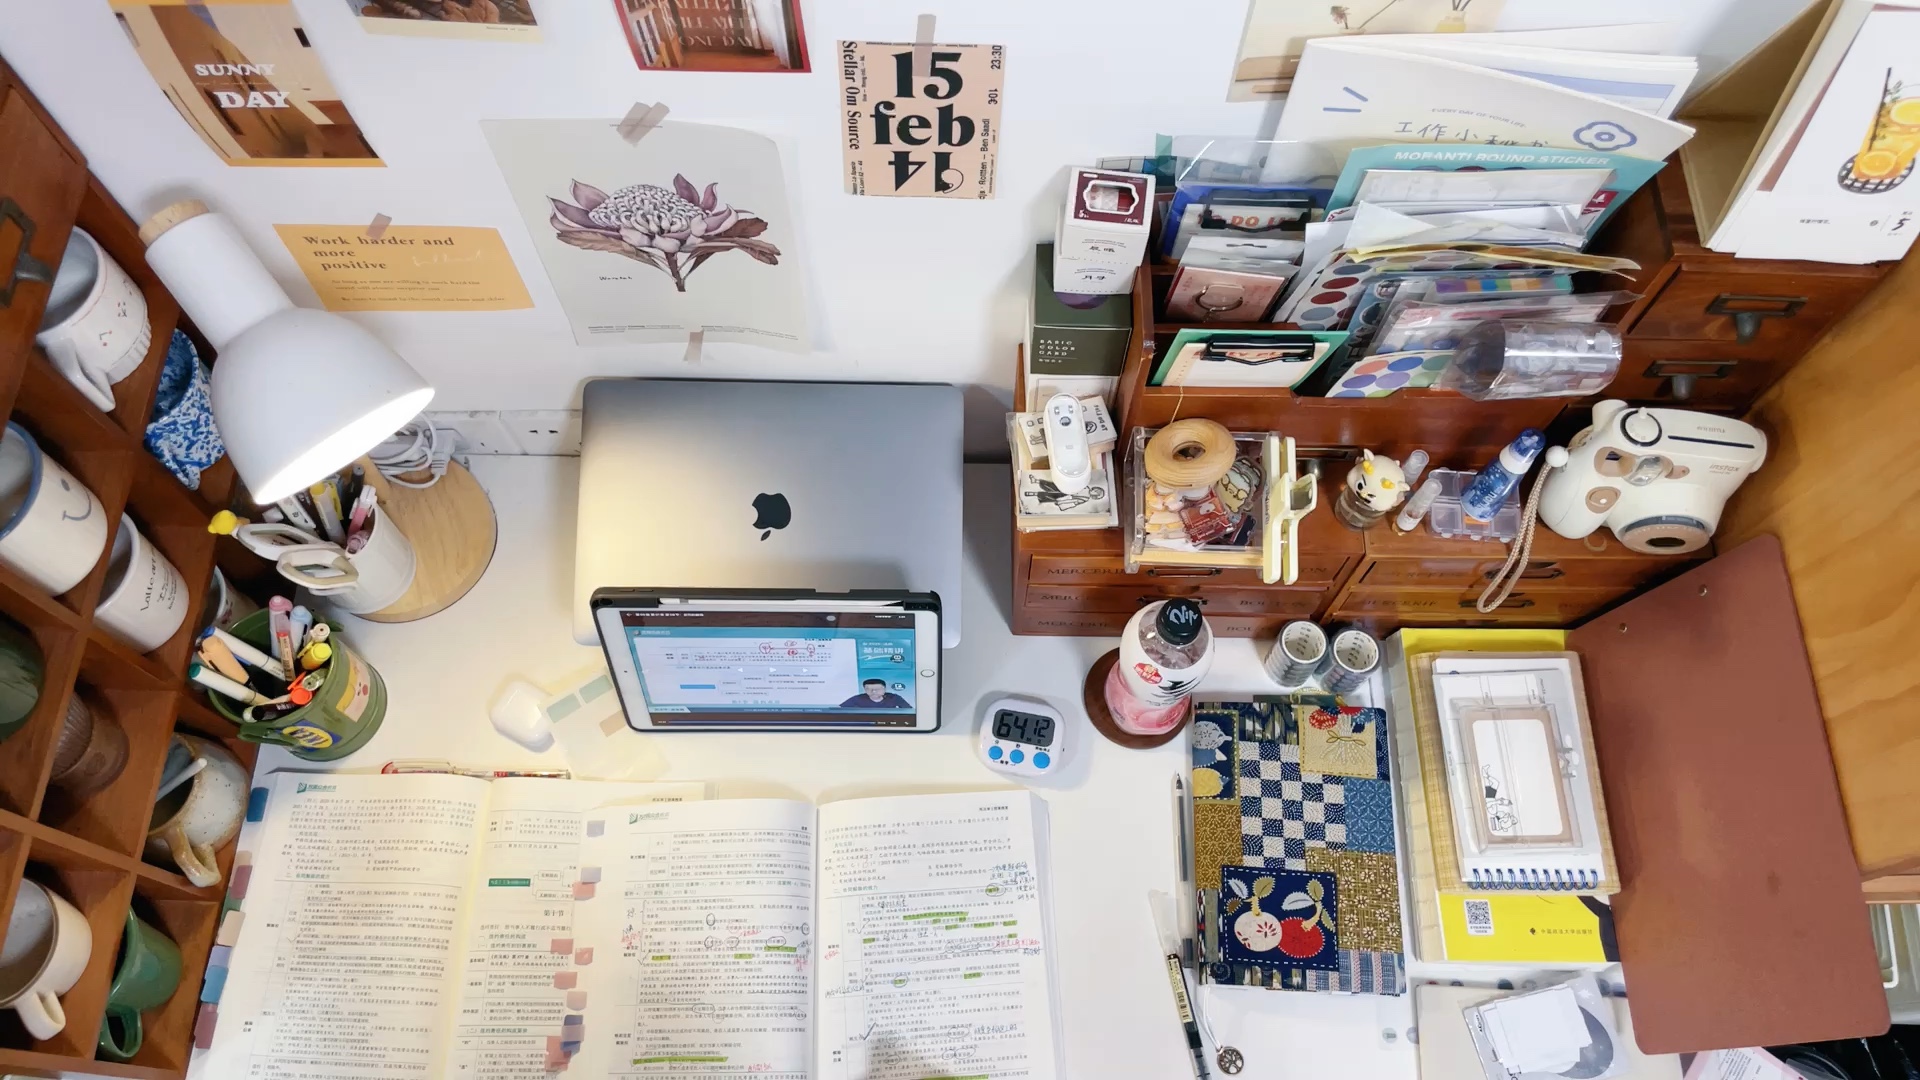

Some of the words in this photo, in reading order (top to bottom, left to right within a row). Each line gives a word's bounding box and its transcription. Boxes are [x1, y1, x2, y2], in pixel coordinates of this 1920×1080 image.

[842, 40, 858, 83] Stellar
[990, 45, 1002, 70] 23:30
[194, 64, 275, 76] SUNNY
[891, 51, 963, 100] 15
[213, 91, 290, 108] DAY
[846, 86, 861, 106] Om
[847, 111, 862, 150] Source
[870, 101, 975, 147] feb
[1475, 152, 1536, 163] ROUND
[1539, 155, 1610, 165] STICKER
[302, 236, 350, 246] Work
[357, 236, 415, 246] harder
[423, 237, 455, 246] and
[313, 249, 355, 258] more
[321, 261, 387, 272] positive
[1708, 463, 1740, 472] instax
